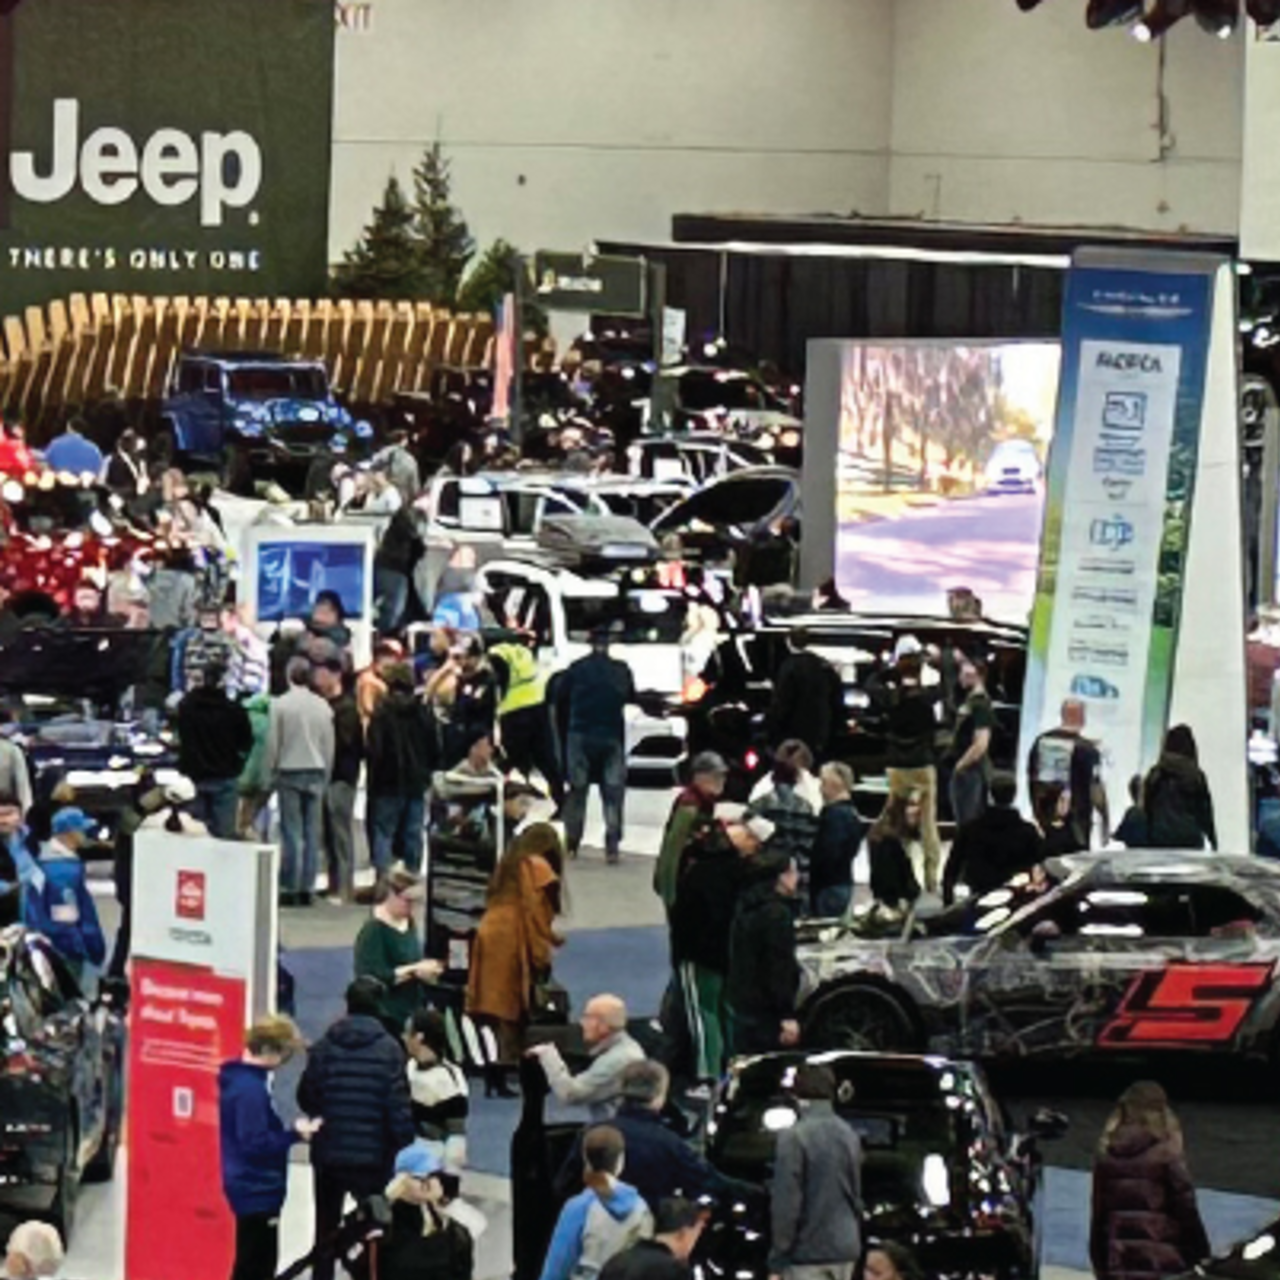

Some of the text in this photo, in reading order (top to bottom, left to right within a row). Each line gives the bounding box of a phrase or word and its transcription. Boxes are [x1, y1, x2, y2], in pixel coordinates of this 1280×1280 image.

[334, 3, 372, 30] XIT
[9, 247, 261, 269] THERE'S ONLY ONE
